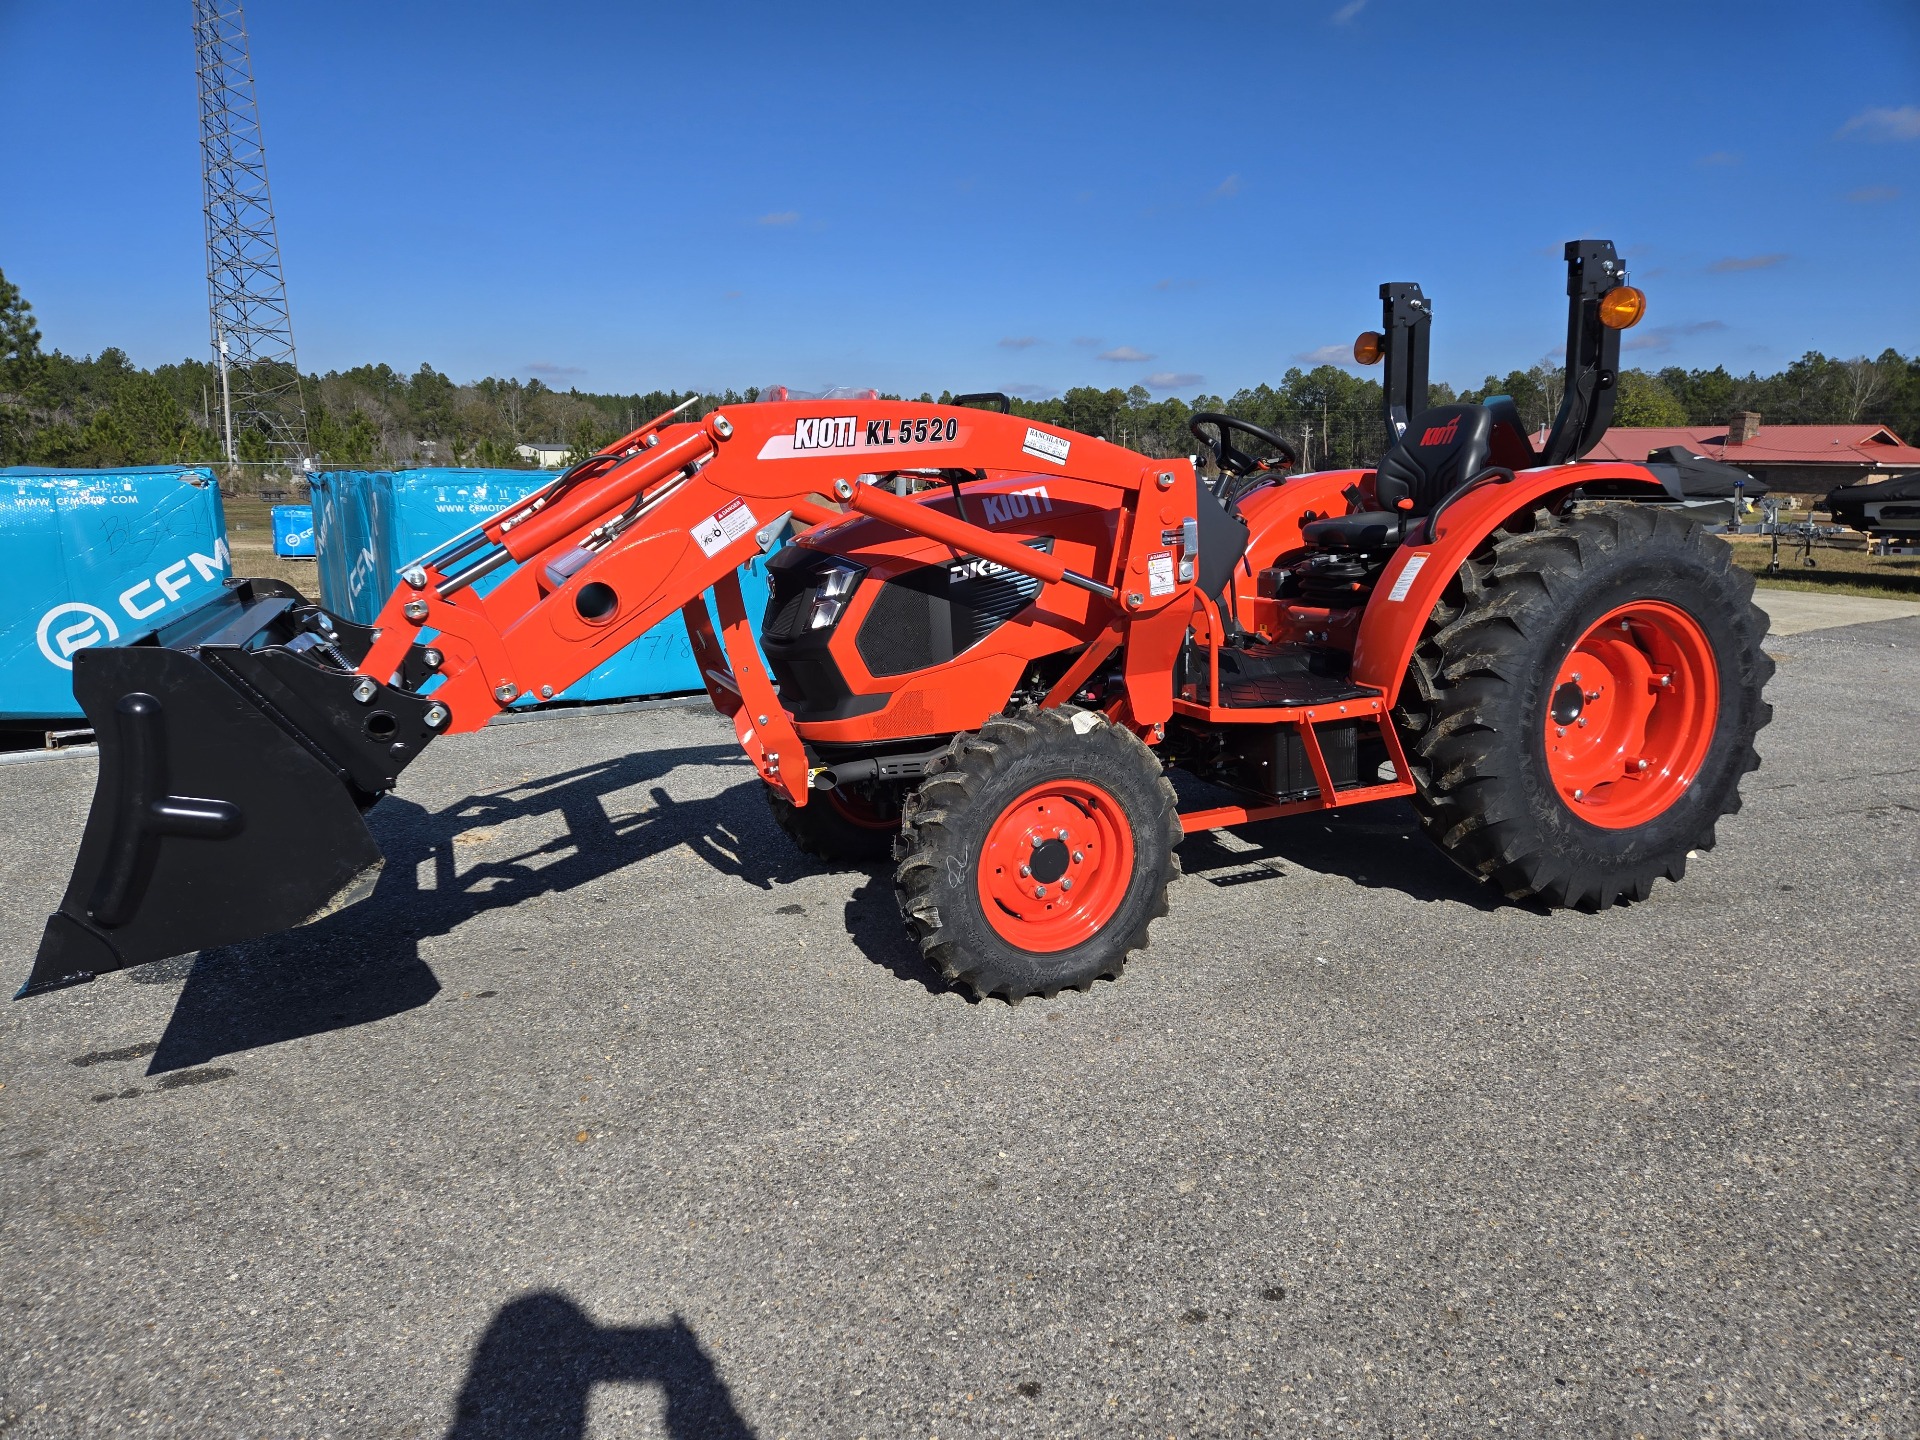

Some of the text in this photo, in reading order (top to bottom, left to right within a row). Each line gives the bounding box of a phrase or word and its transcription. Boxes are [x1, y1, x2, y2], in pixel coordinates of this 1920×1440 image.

[794, 416, 857, 449] KIOTI
[721, 500, 741, 516] DANGER
[981, 486, 1053, 525] KIOTI
